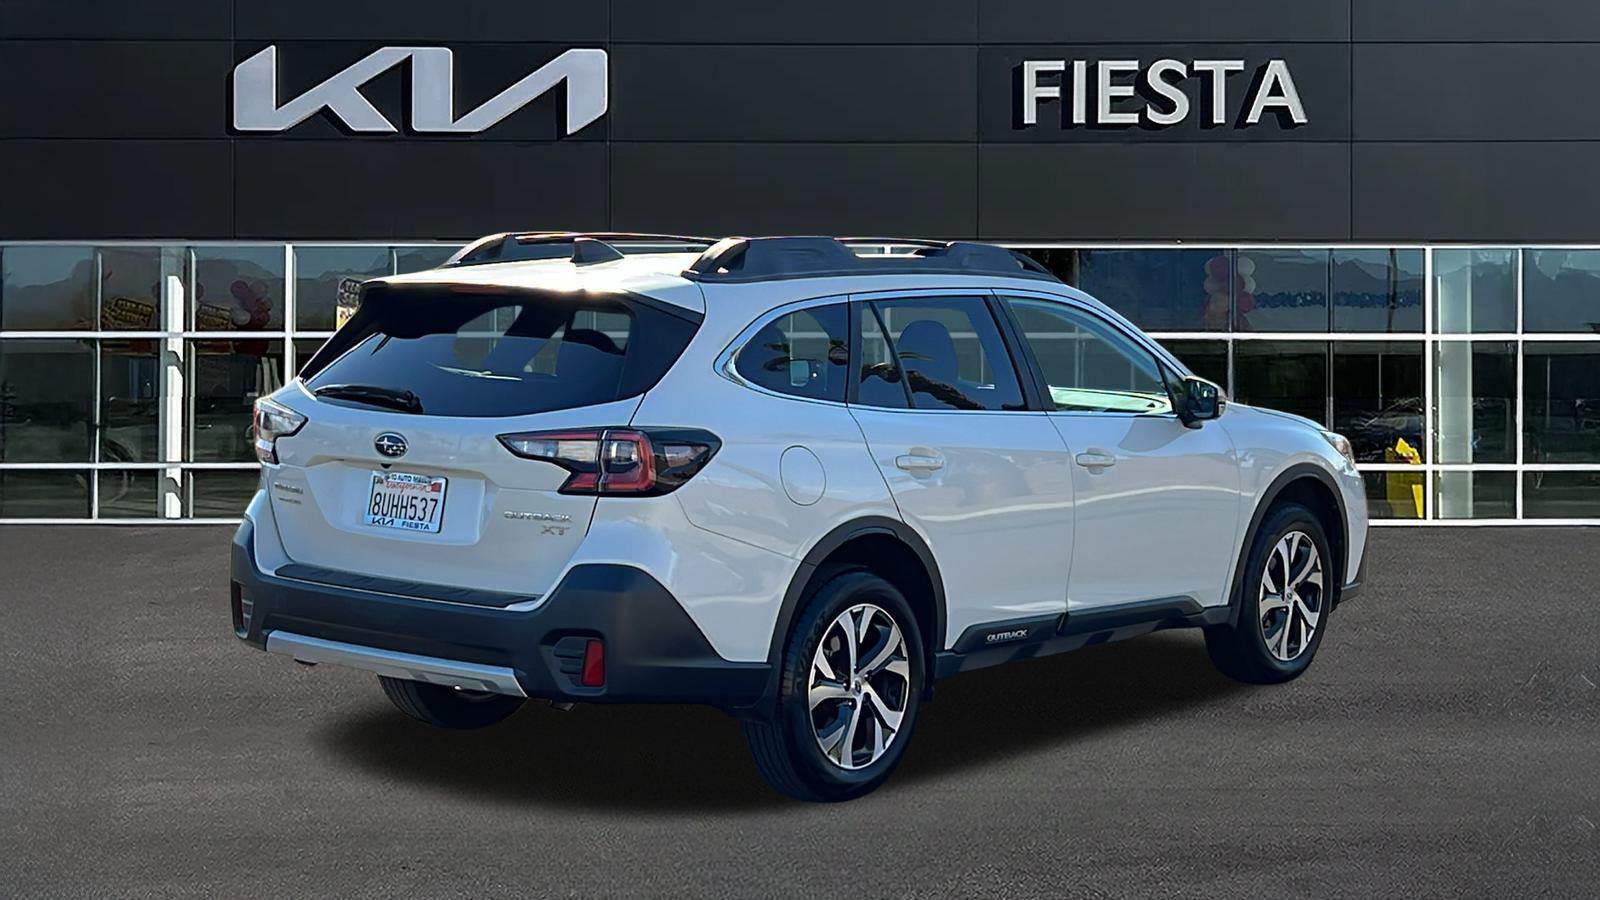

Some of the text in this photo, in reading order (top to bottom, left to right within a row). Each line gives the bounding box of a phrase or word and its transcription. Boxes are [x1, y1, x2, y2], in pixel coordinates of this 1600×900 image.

[233, 44, 608, 135] KIA
[1023, 59, 1309, 125] FIESTA
[398, 474, 412, 482] AUTO
[372, 492, 438, 523] 8UHH537
[504, 511, 572, 522] OUTBACK
[402, 521, 430, 530] FIESTA
[541, 525, 570, 536] XT
[987, 629, 1028, 642] OUTBACK
